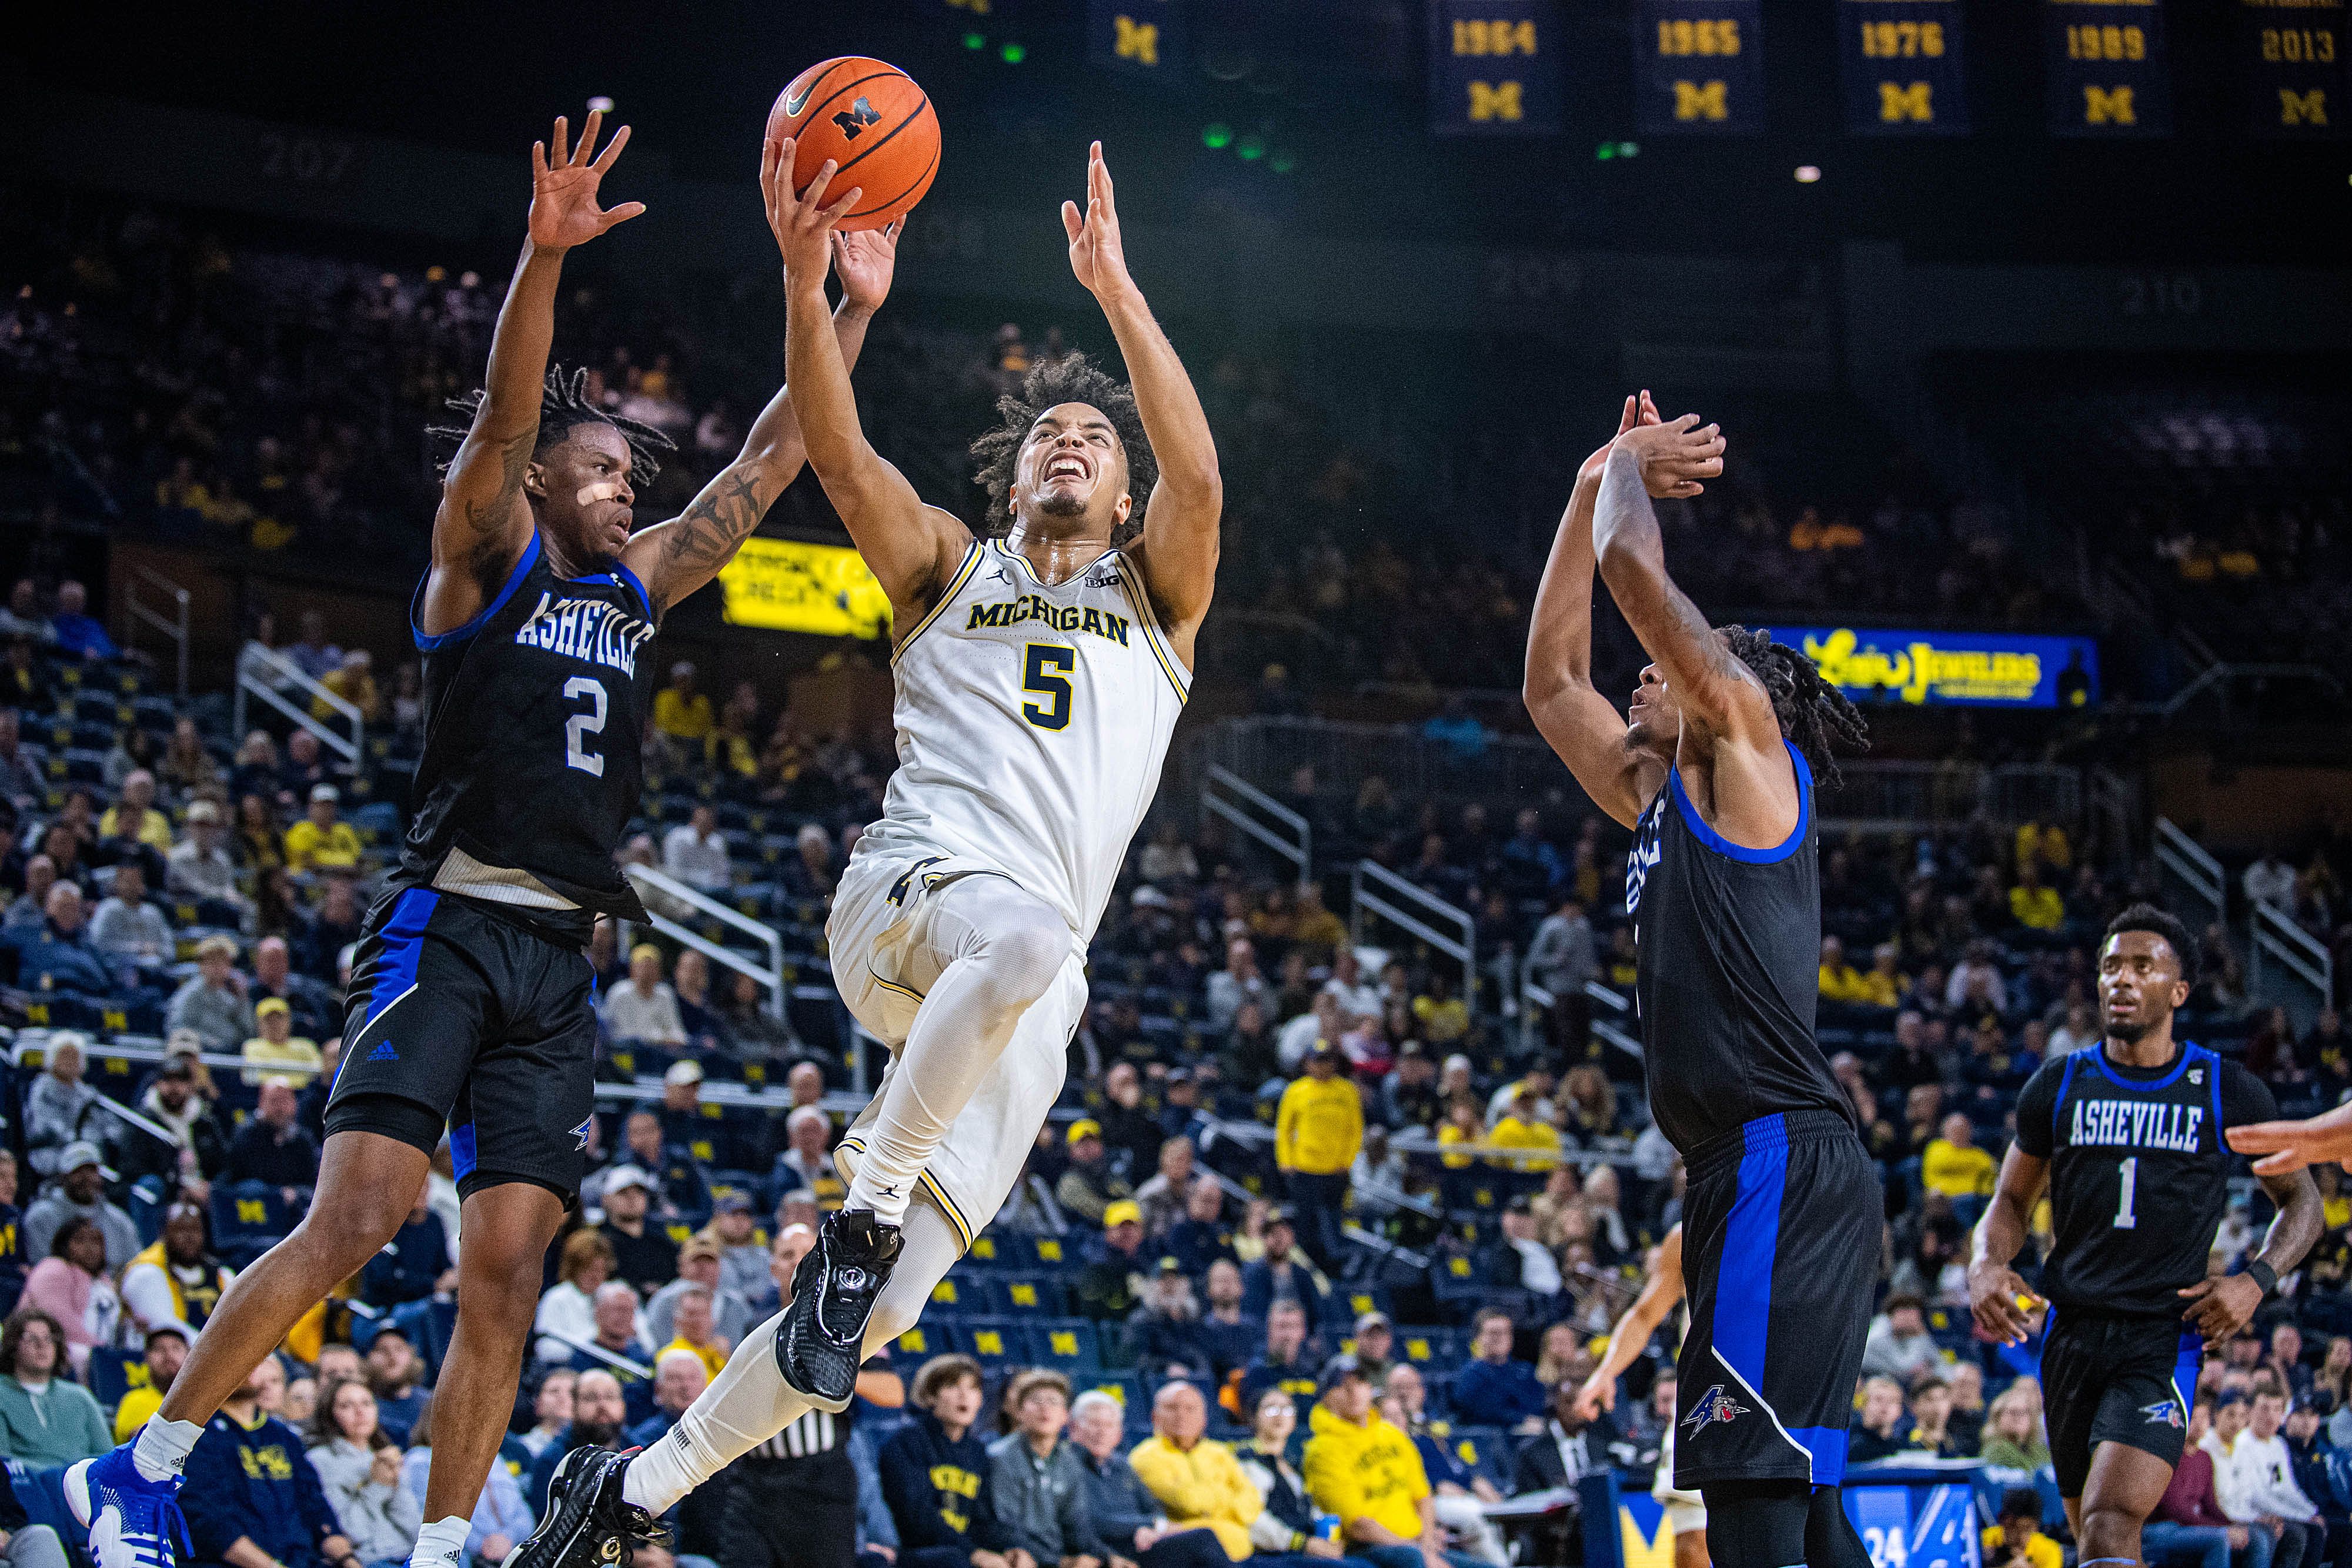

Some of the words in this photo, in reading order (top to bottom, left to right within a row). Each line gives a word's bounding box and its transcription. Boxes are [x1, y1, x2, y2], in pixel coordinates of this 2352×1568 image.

[1862, 21, 1945, 57] 1976
[2262, 29, 2335, 62] 2013
[831, 95, 882, 142] M
[1468, 81, 1523, 120] M
[1673, 81, 1728, 121] M
[1879, 82, 1933, 121] M
[2084, 85, 2136, 123] M
[2279, 89, 2328, 125] M
[965, 594, 1130, 648] MICHIGAN
[1021, 642, 1076, 733] 5
[563, 675, 608, 777] 2
[2070, 1099, 2204, 1154] ASHEVILLE
[2113, 1156, 2137, 1229] 1
